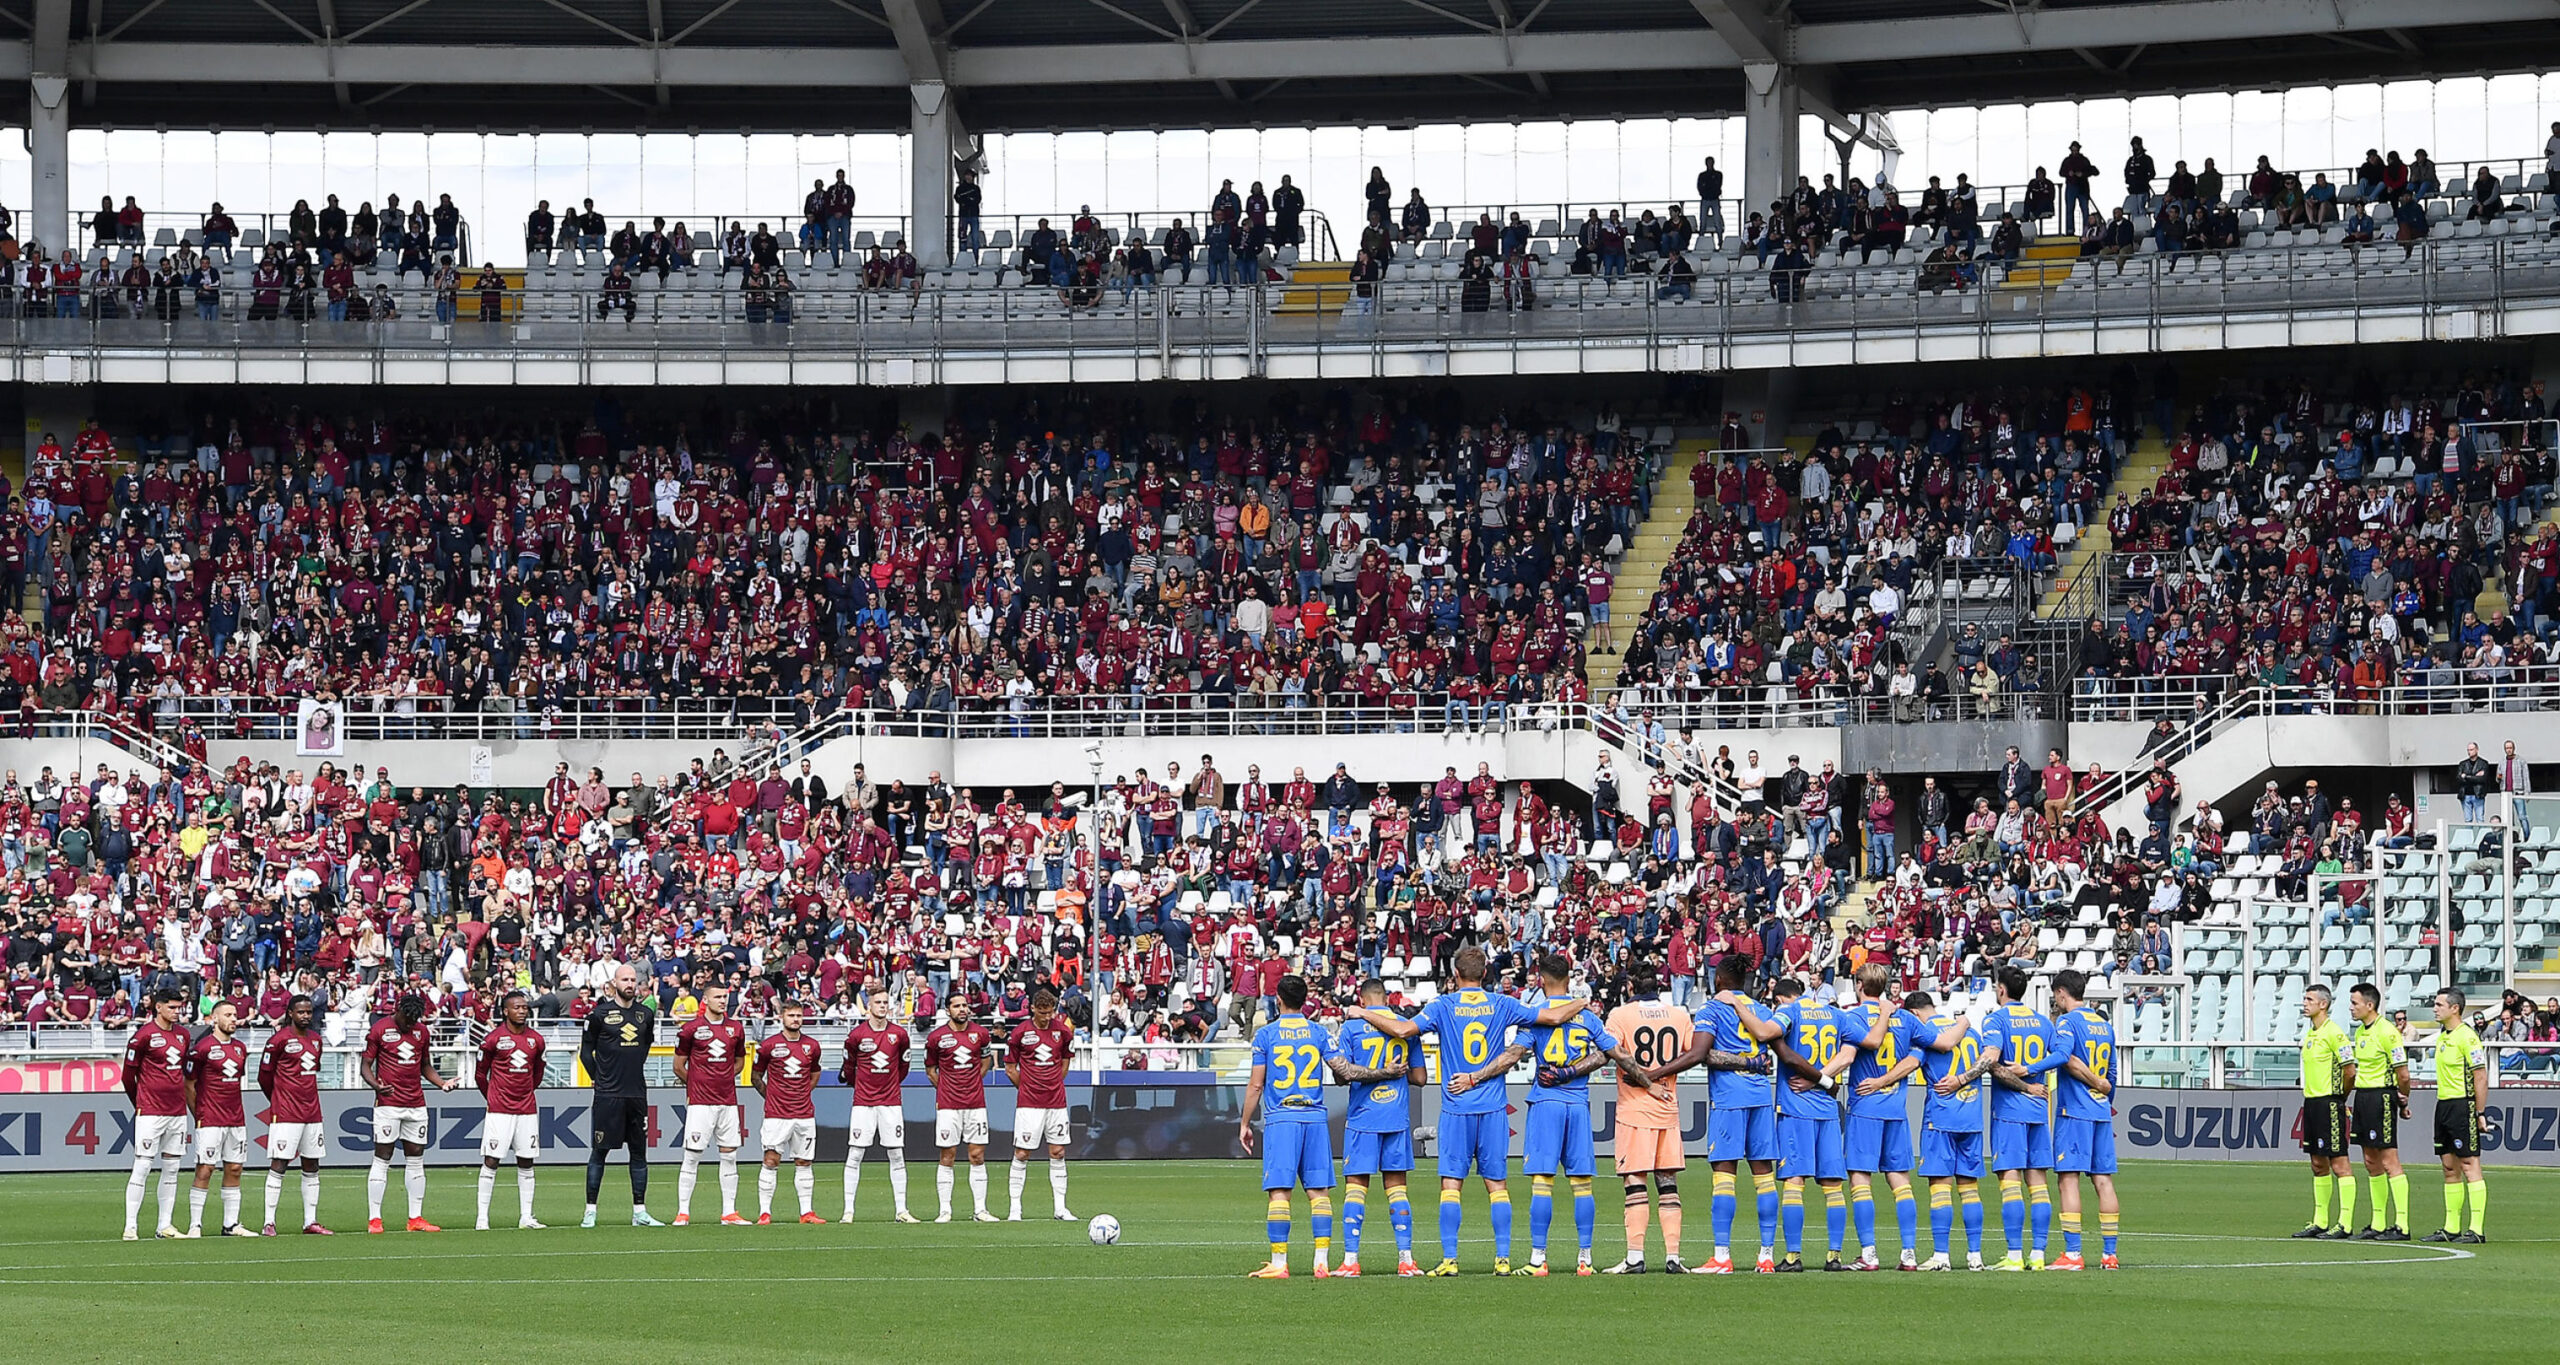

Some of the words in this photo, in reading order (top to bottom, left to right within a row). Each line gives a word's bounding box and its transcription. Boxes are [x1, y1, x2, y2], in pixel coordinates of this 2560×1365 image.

[1455, 1005, 1494, 1018] ROMAGNOLI
[1639, 1009, 1670, 1019] TURATI
[2010, 1018, 2042, 1028] ZORTEA
[1279, 1029, 1311, 1040] VALERI
[1361, 1036, 1409, 1070] 70
[1463, 1021, 1488, 1065] 6
[1543, 1027, 1589, 1067] 45
[1633, 1025, 1679, 1068] 80
[1800, 1024, 1838, 1068] 36
[1875, 1032, 1897, 1072] 4
[1273, 1044, 1321, 1090] 32
[2085, 1039, 2112, 1080] 18
[317, 1133, 325, 1148] 6
[418, 1125, 426, 1139] 9
[805, 1137, 814, 1151] 7
[895, 1125, 903, 1138] 8
[2127, 1105, 2281, 1149] SUZUKI
[2480, 1104, 2560, 1151] SUZ
